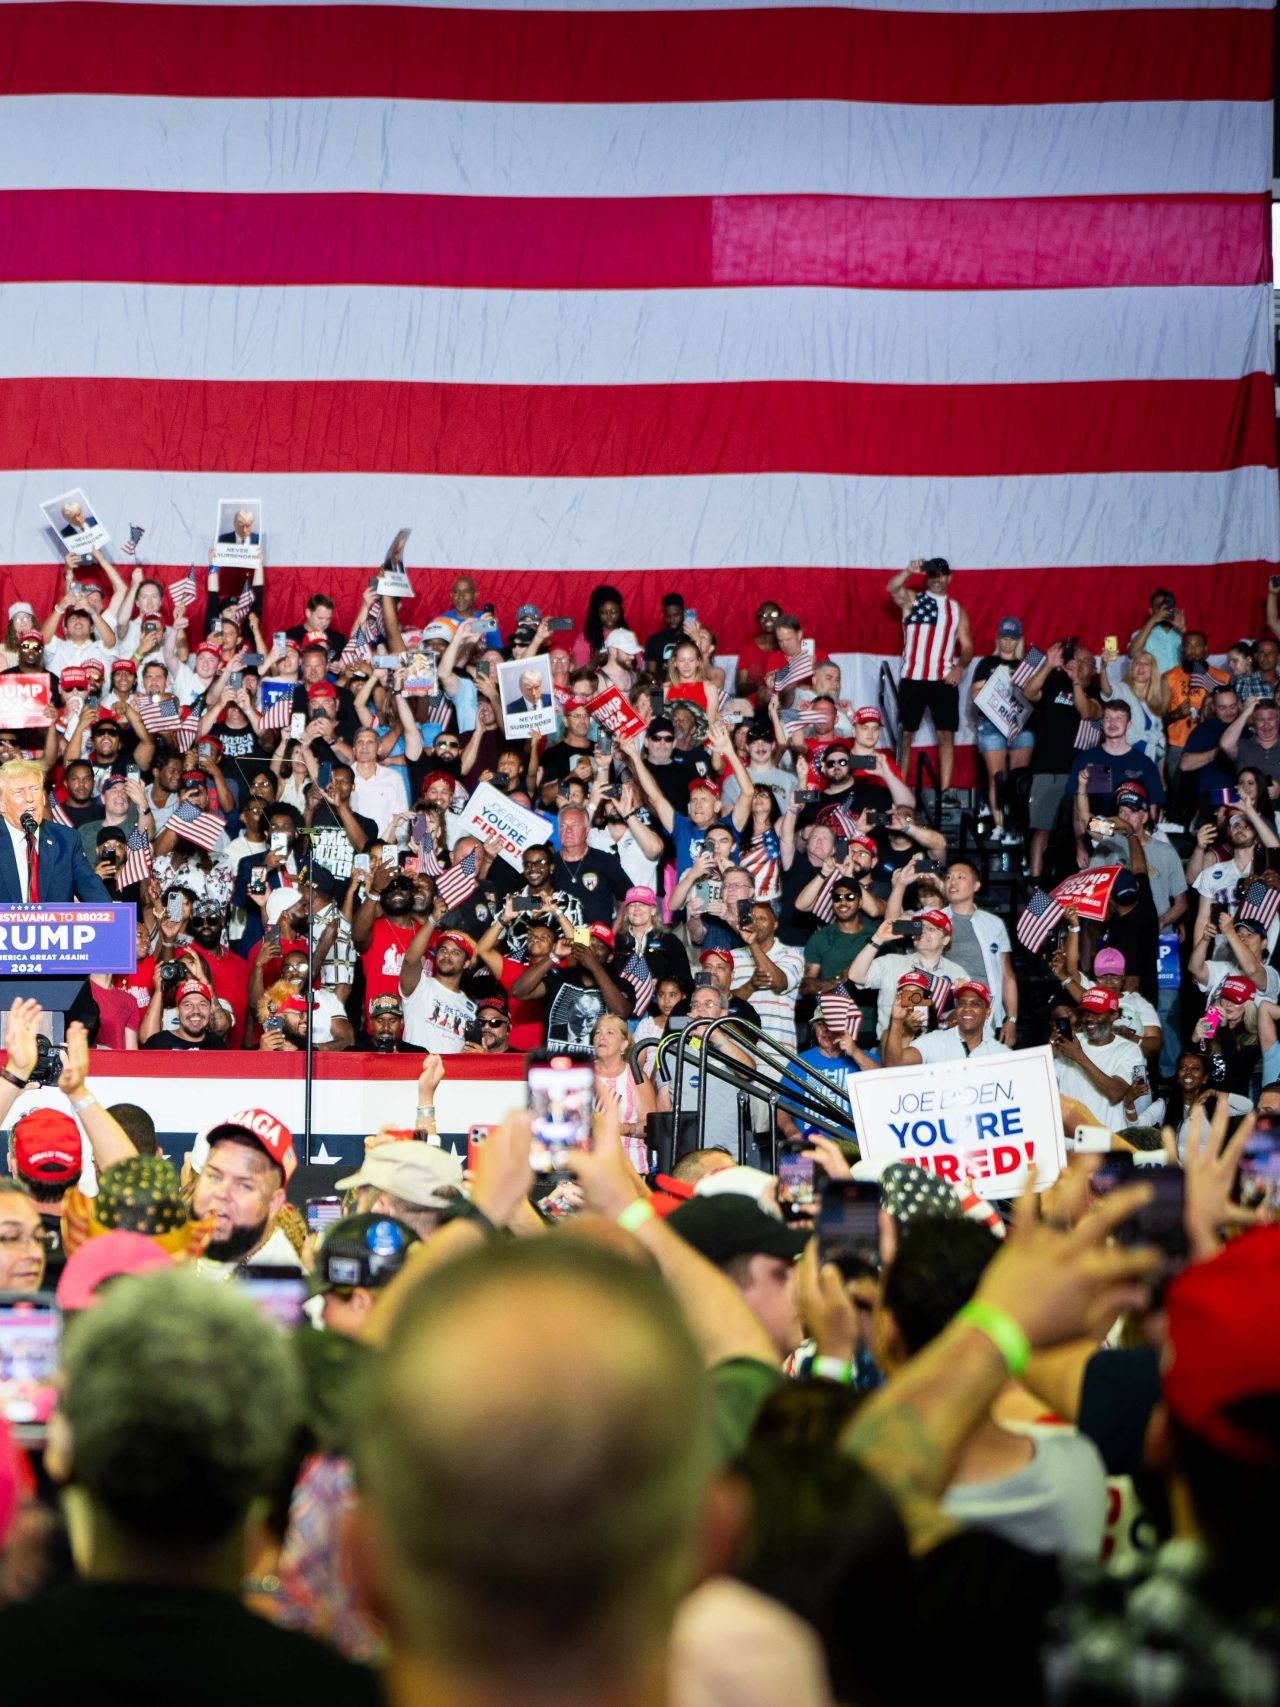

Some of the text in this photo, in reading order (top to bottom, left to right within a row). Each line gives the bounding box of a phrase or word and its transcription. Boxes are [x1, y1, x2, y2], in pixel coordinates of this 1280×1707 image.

[510, 718, 552, 731] SURRENDER
[519, 713, 543, 723] NEVER
[602, 711, 628, 731] 024
[481, 806, 527, 846] YOU'RE
[60, 914, 74, 922] TO
[76, 913, 111, 922] 88022
[10, 963, 43, 973] 2024
[890, 1080, 1014, 1114] JOE BDEN,
[888, 1107, 1023, 1149] YOU'RE
[899, 1141, 1035, 1183] IRED!
